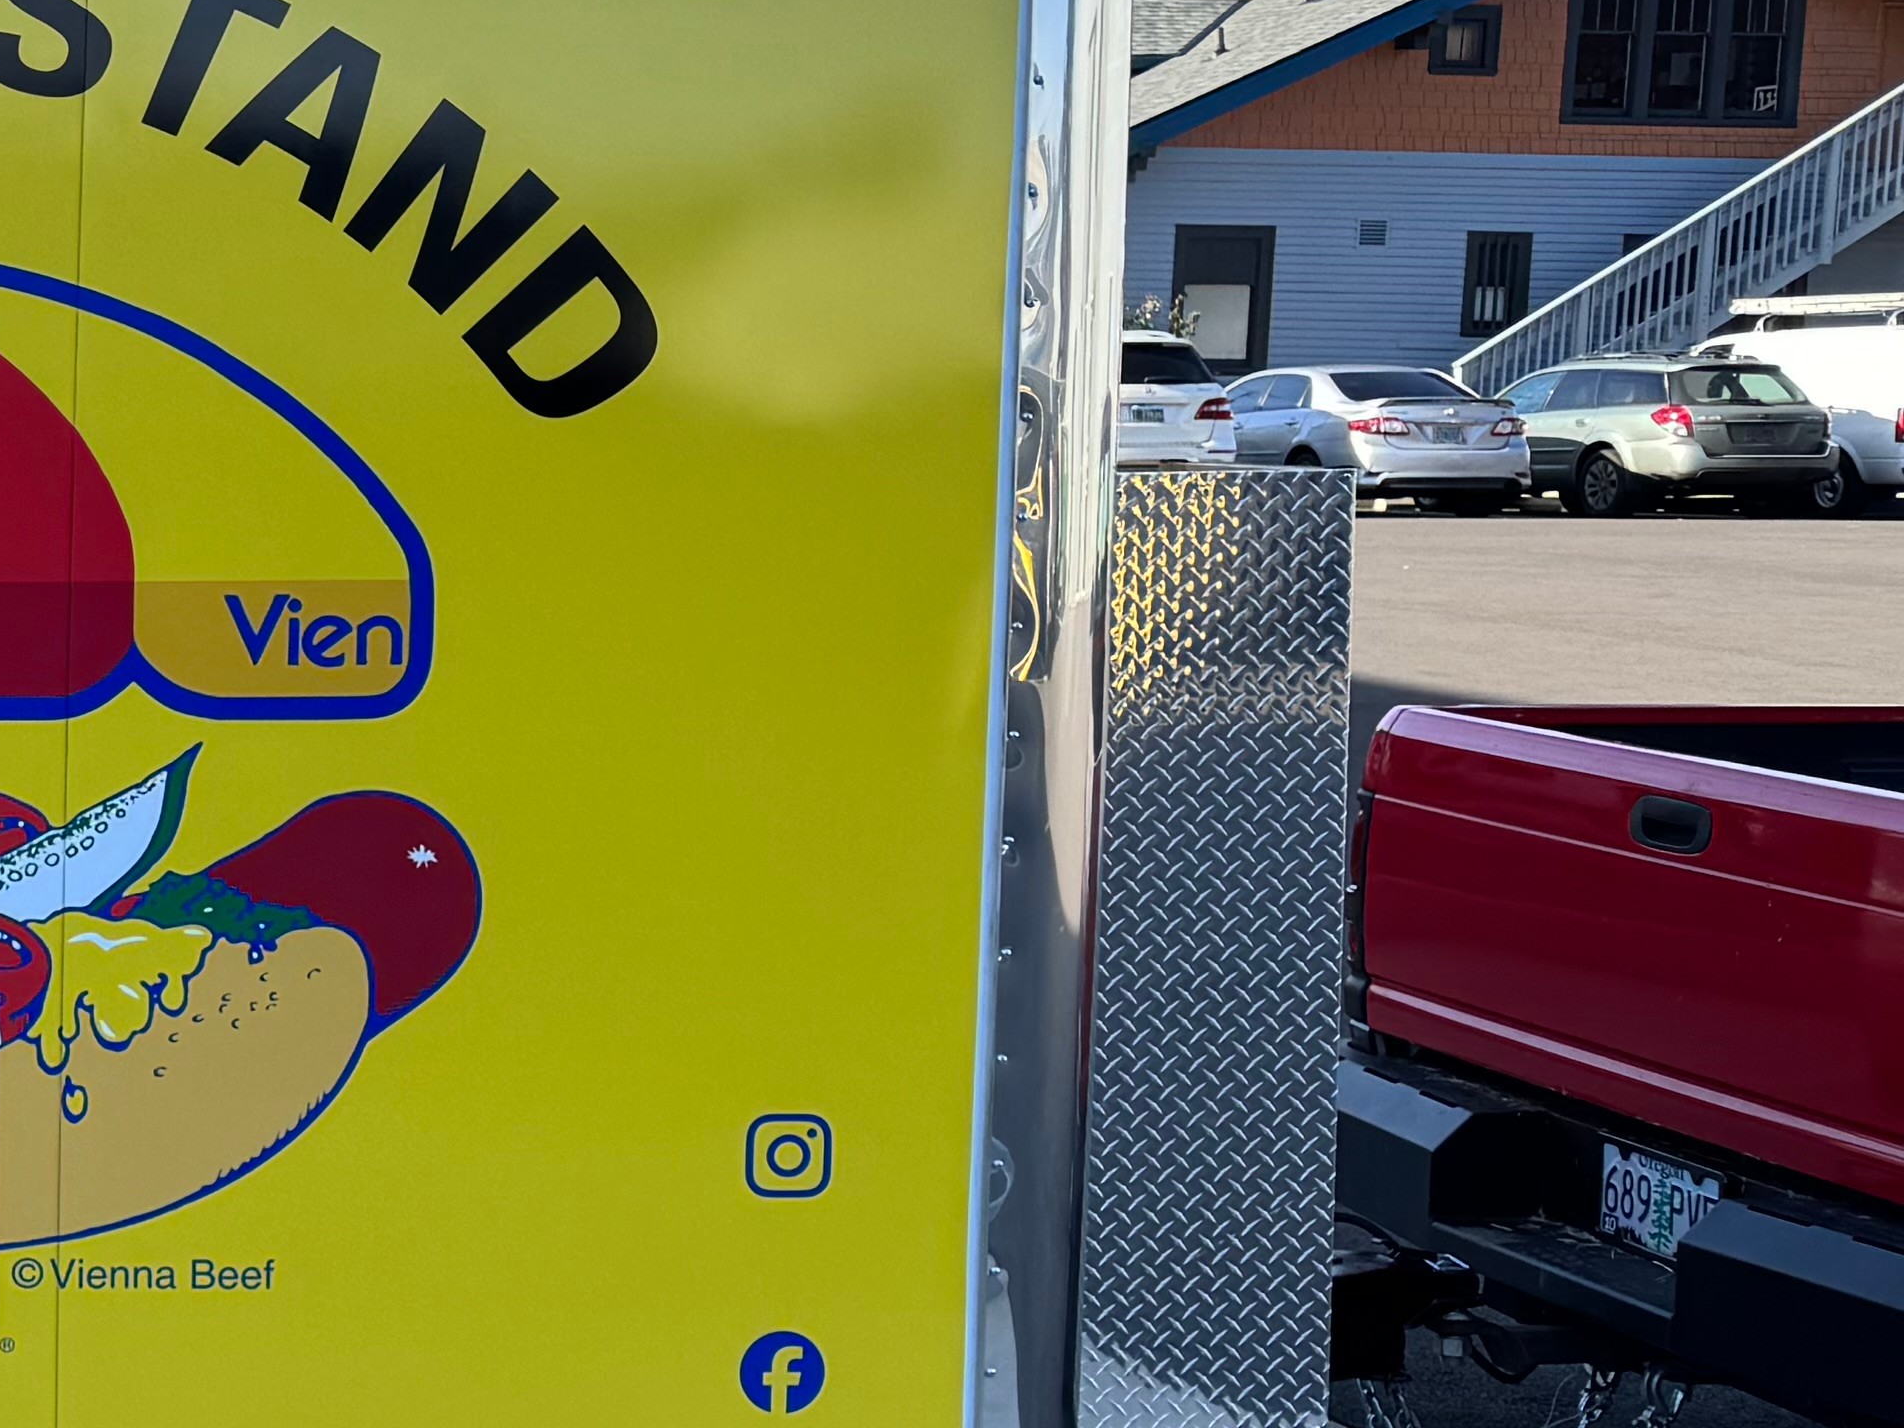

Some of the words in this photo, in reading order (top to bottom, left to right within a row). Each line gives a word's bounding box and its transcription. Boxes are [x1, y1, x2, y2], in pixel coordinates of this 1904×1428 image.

[223, 594, 404, 668] Vien
[1604, 1164, 1652, 1224] 689
[190, 1258, 276, 1290] Beef
